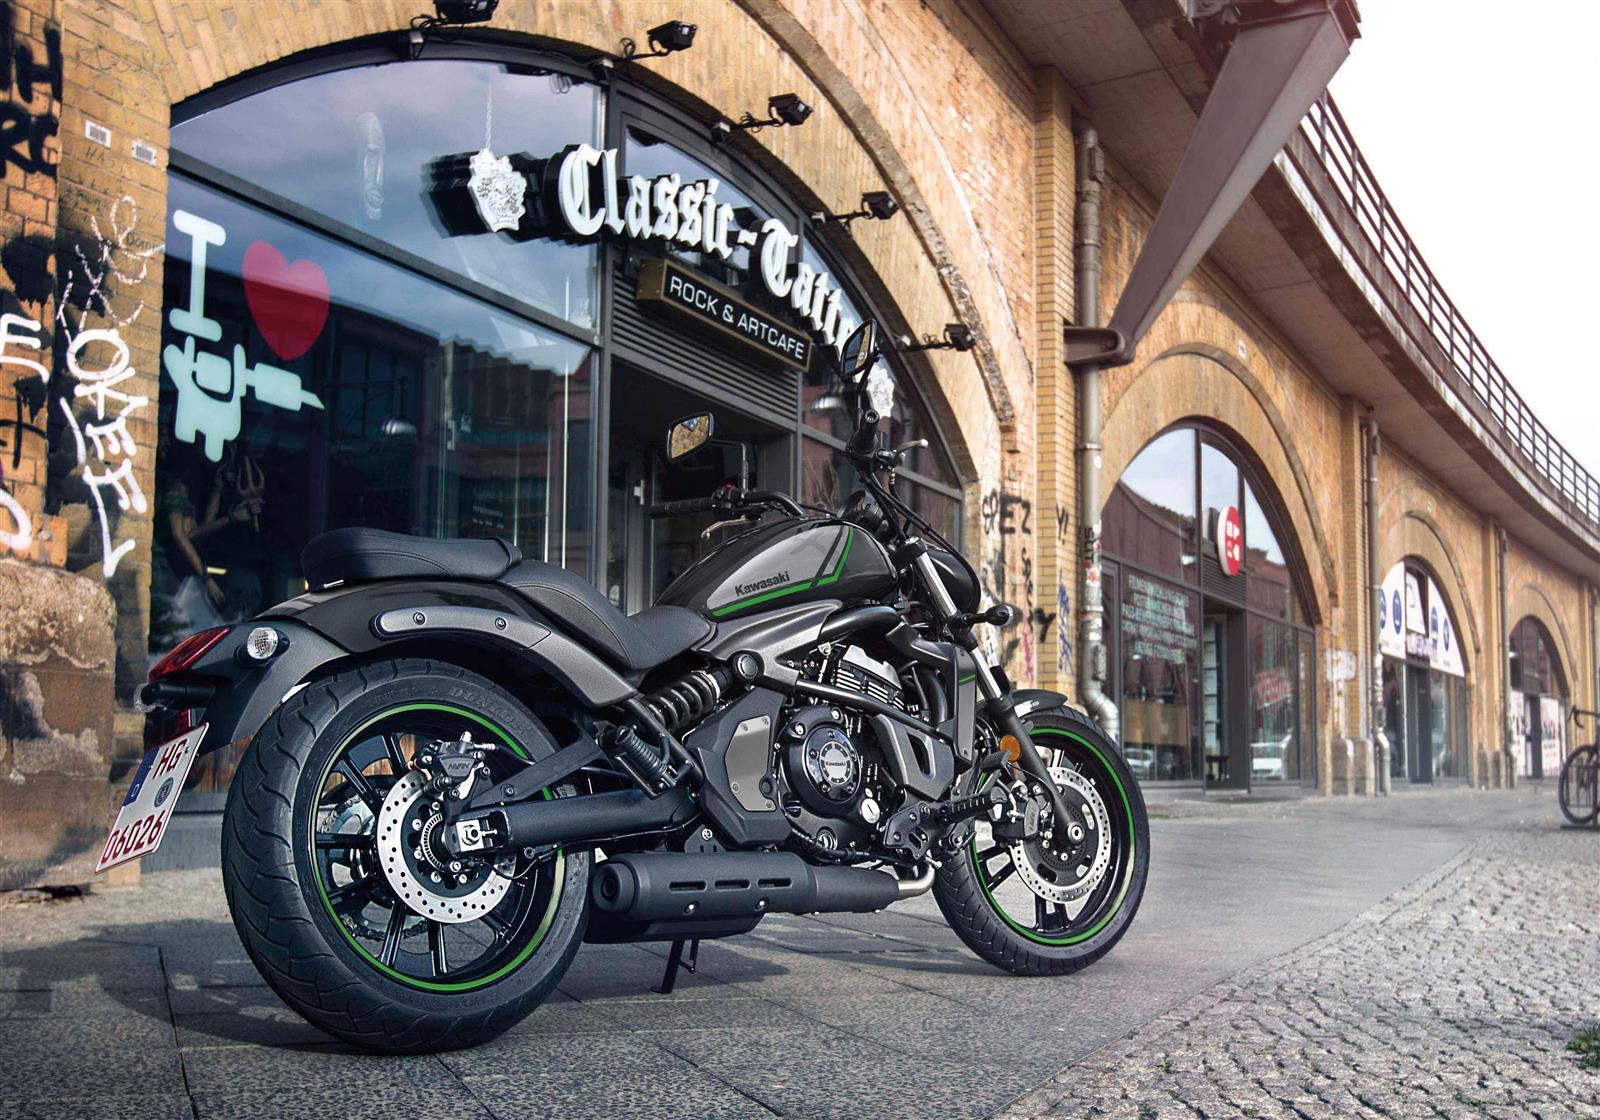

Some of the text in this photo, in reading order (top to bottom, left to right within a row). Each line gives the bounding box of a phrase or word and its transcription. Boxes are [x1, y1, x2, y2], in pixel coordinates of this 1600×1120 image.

[670, 275, 805, 360] ROCK & ARTCAFE
[734, 570, 791, 598] Kawasaki
[153, 738, 188, 780] HG
[101, 810, 166, 865] 06026
